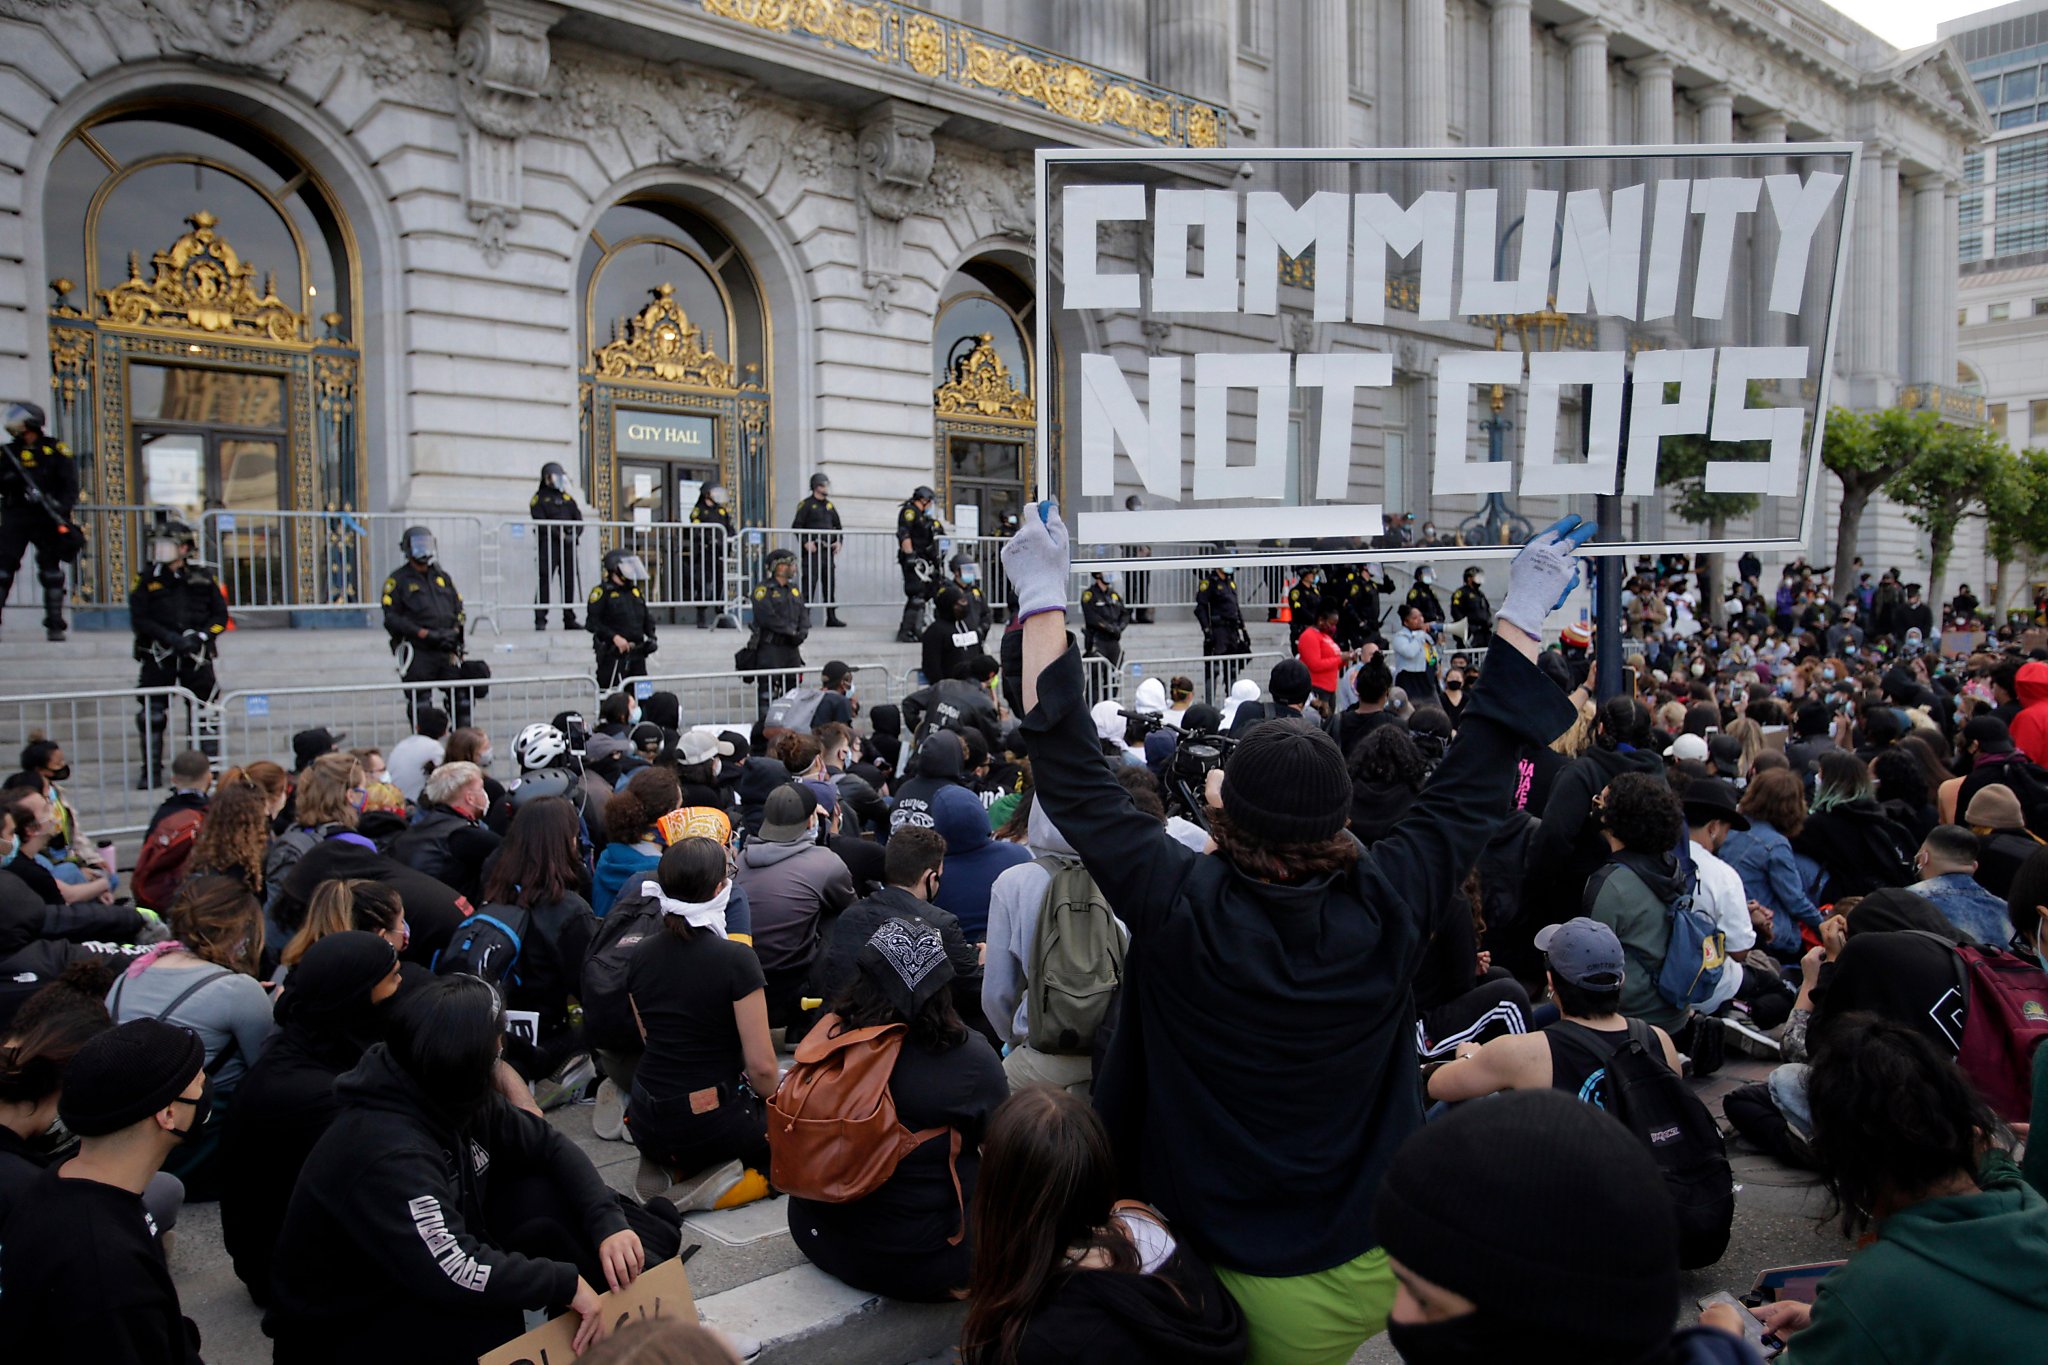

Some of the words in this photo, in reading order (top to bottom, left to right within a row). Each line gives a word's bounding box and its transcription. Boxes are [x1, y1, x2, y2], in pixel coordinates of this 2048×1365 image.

[1063, 171, 1844, 326] COMMUNITY
[628, 424, 662, 441] CITY
[665, 427, 701, 444] HALL
[1081, 353, 1393, 502] NOT
[1431, 346, 1809, 497] COPS
